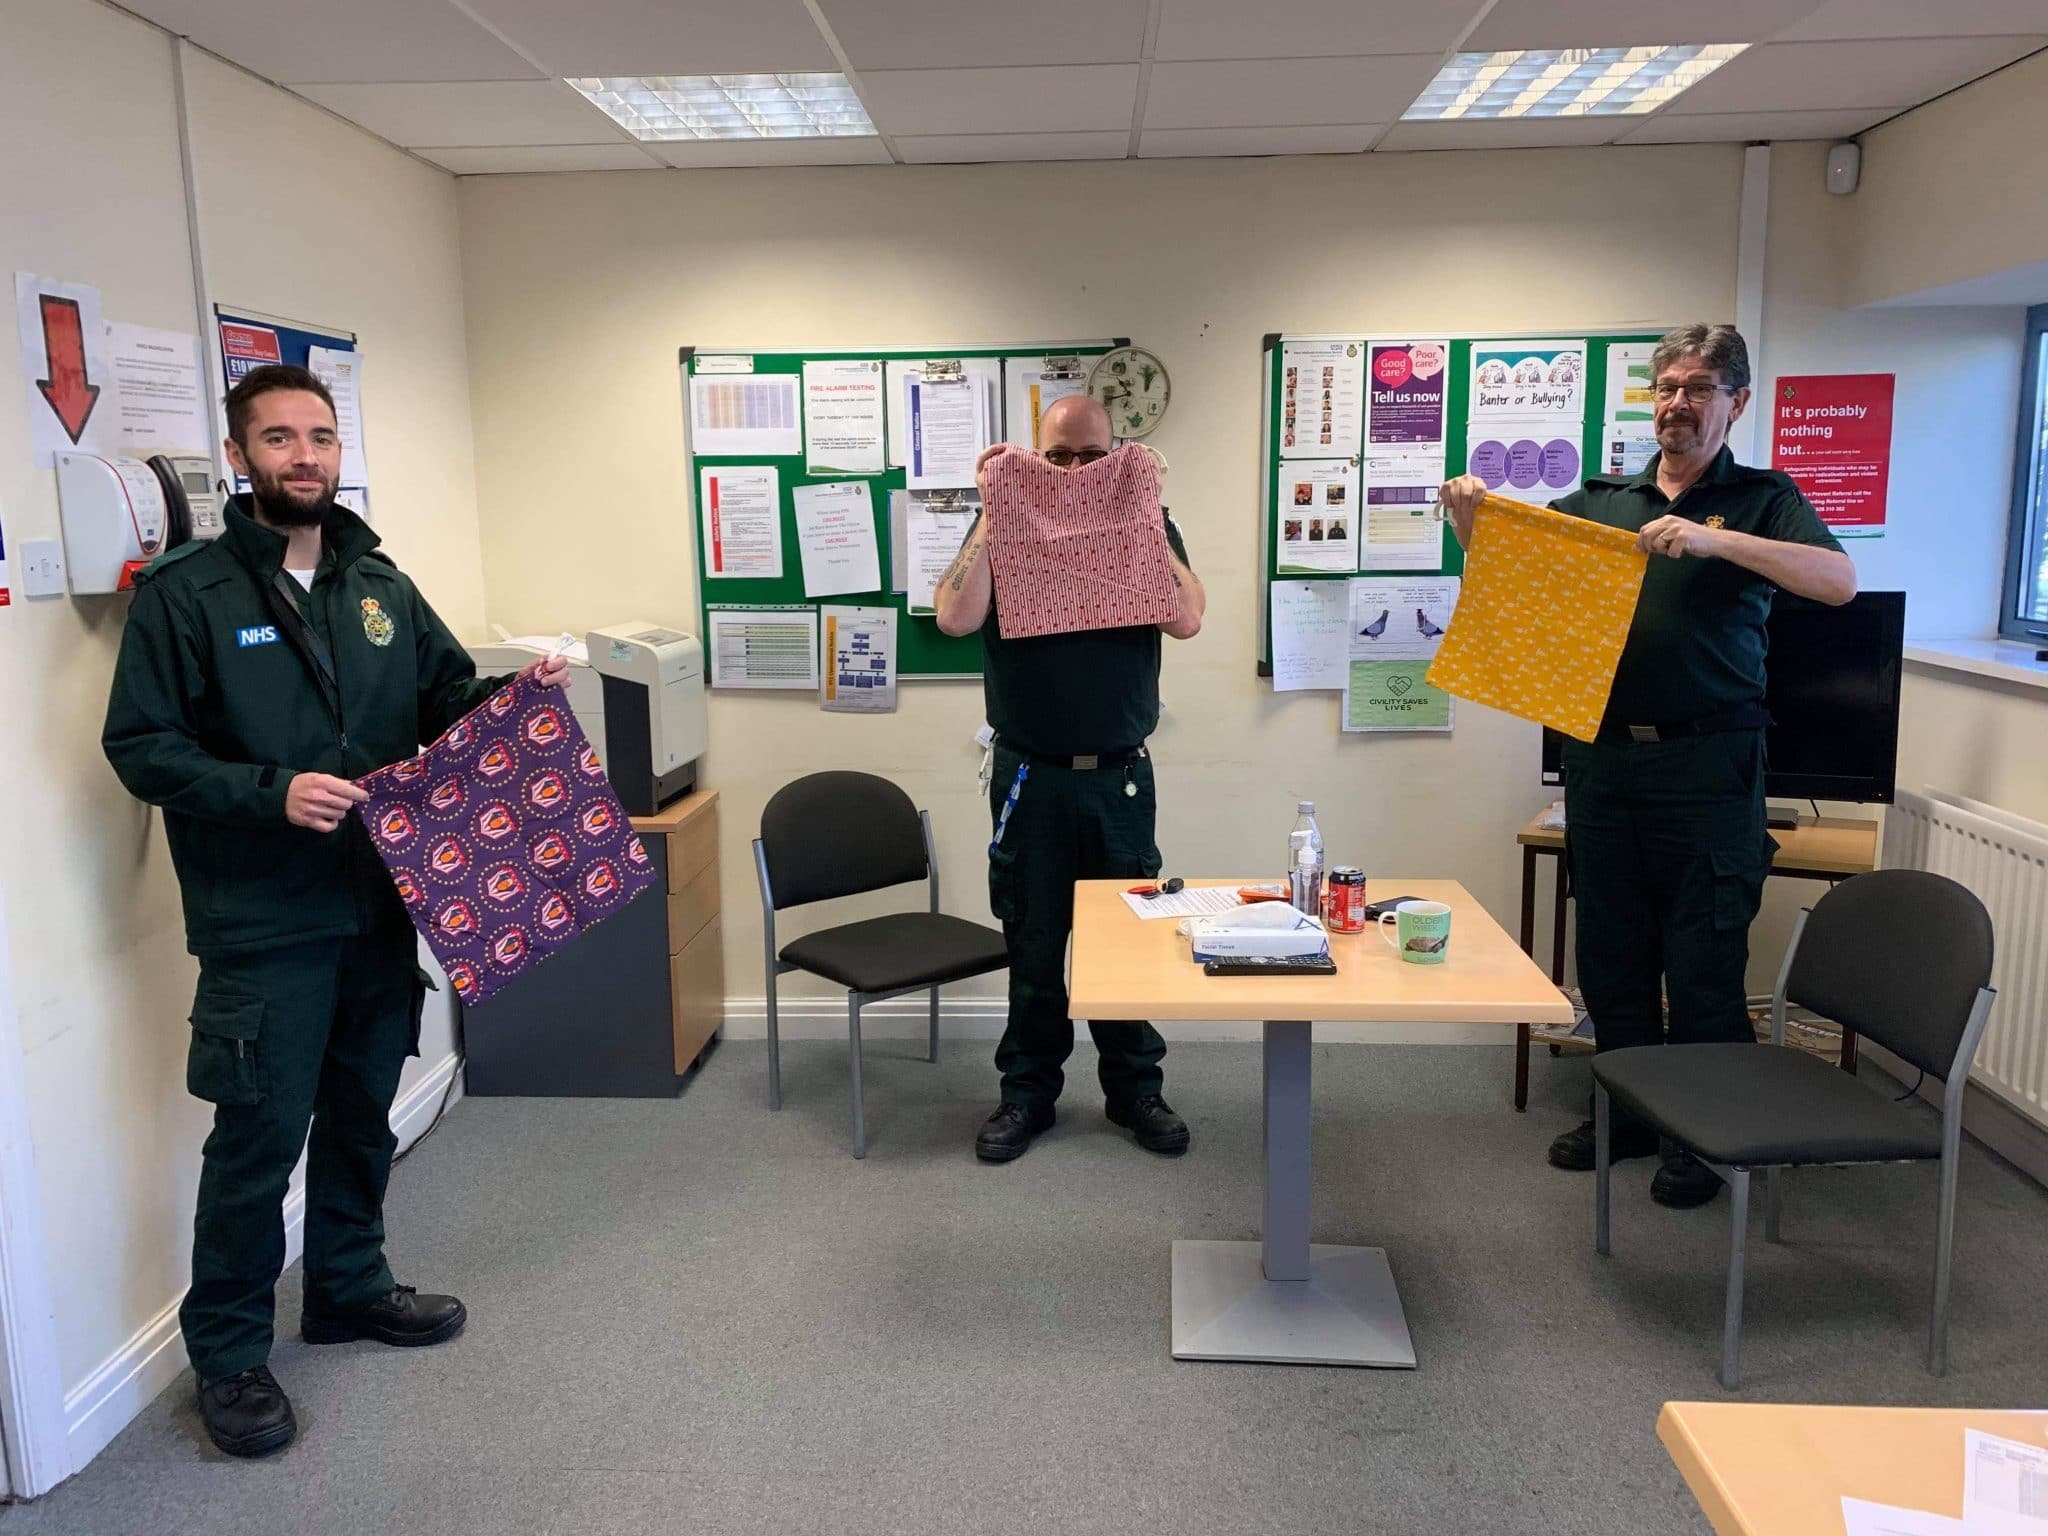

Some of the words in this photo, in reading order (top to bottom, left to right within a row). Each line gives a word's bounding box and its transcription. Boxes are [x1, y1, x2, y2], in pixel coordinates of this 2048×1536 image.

[1415, 350, 1436, 359] Poor
[231, 359, 247, 373] £10
[1381, 358, 1406, 368] Good
[1415, 359, 1438, 368] care?
[1380, 368, 1406, 377] care?
[1372, 390, 1394, 403] Tell
[1396, 393, 1411, 403] us
[1413, 392, 1440, 402] now
[1515, 396, 1526, 405] or
[1531, 389, 1573, 409] Bullying?
[1781, 406, 1802, 418] It's
[1806, 404, 1867, 419] probably
[1780, 425, 1833, 439] nothing
[1779, 444, 1815, 456] but...
[241, 626, 276, 645] NHS
